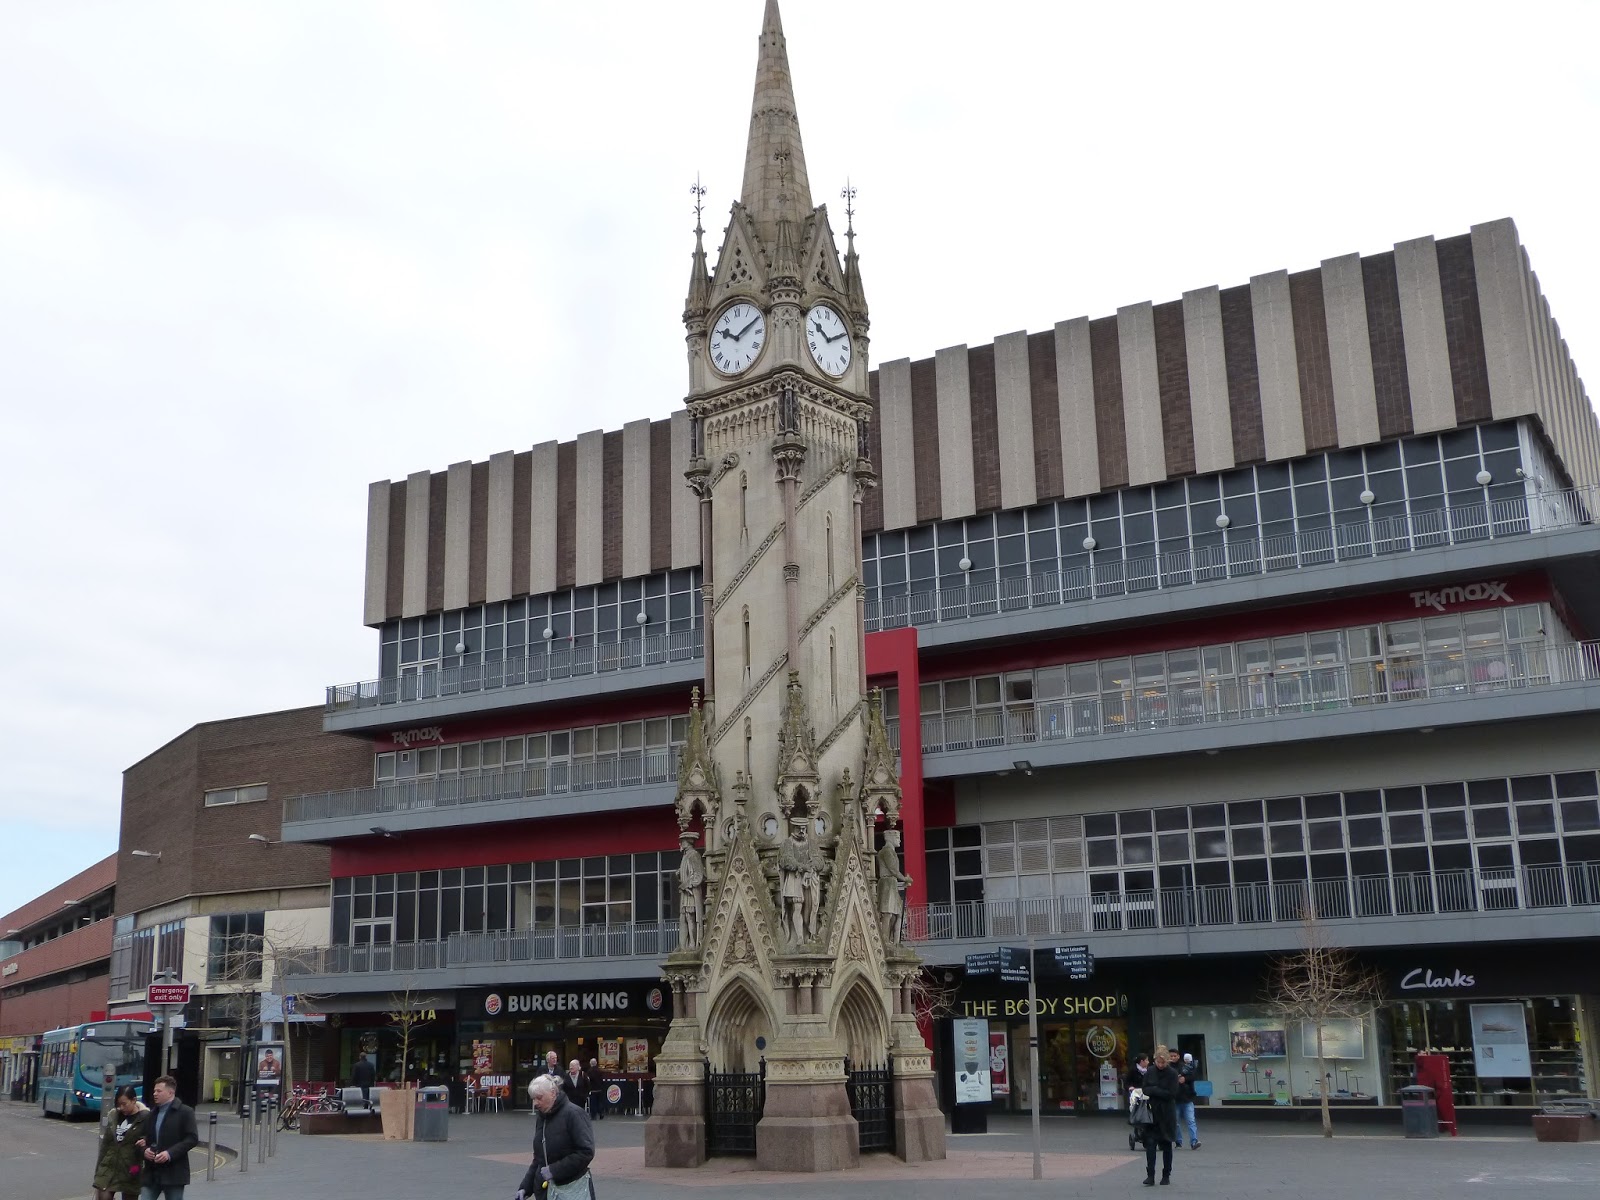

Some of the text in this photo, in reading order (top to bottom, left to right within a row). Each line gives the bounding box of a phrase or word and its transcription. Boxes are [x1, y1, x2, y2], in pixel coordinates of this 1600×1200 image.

[1400, 968, 1476, 990] Clarks
[508, 991, 628, 1013] BURGER KING
[961, 996, 1116, 1017] THE BODY SHOP
